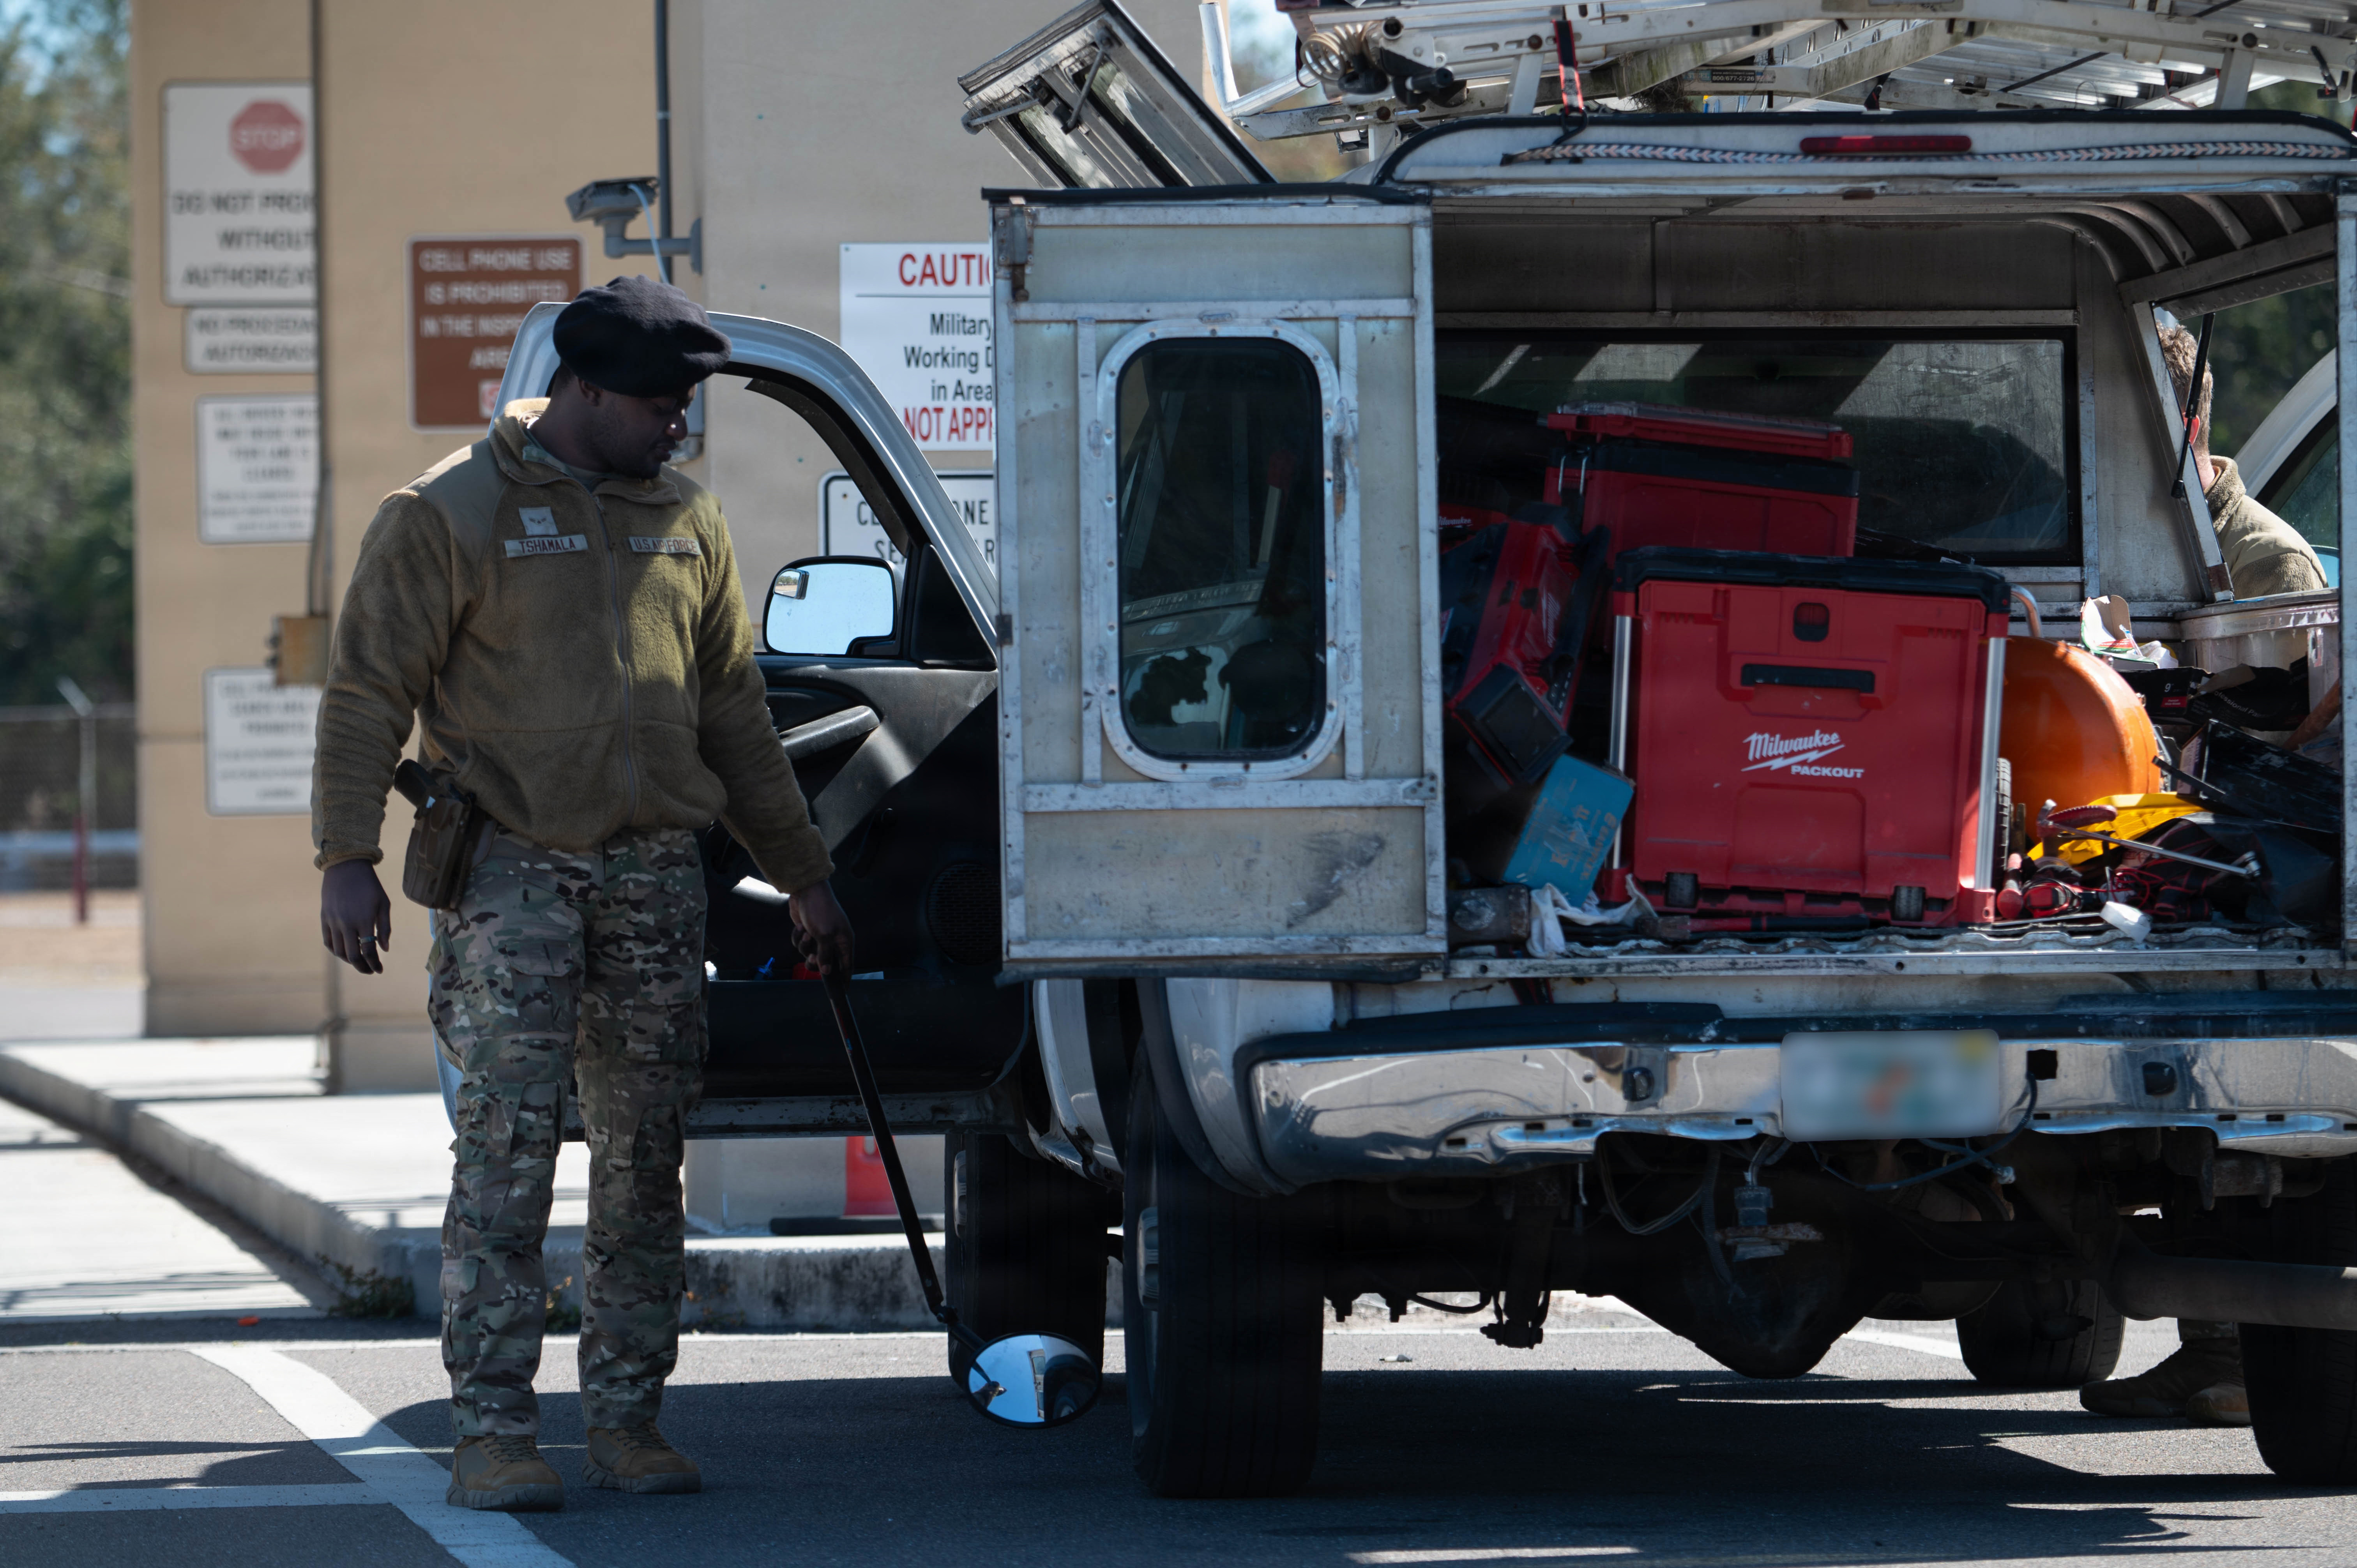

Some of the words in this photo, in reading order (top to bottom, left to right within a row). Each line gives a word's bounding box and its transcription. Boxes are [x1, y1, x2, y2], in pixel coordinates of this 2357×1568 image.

[237, 127, 297, 149] STOP
[419, 249, 467, 271] CELL
[469, 248, 532, 270] PHONE
[534, 247, 573, 270] USE
[899, 253, 990, 287] CAUTI
[424, 281, 445, 305] IS
[448, 280, 568, 304] PROHIBITED
[442, 314, 475, 337] THE
[930, 313, 992, 340] Military
[904, 346, 978, 373] Working
[931, 379, 947, 401] in
[904, 407, 944, 442] NOT
[518, 538, 576, 554] TSHAMALA
[667, 539, 698, 553] FORCE
[1743, 729, 1840, 761] Milwaukee
[1790, 765, 1864, 778] PACKOUT
